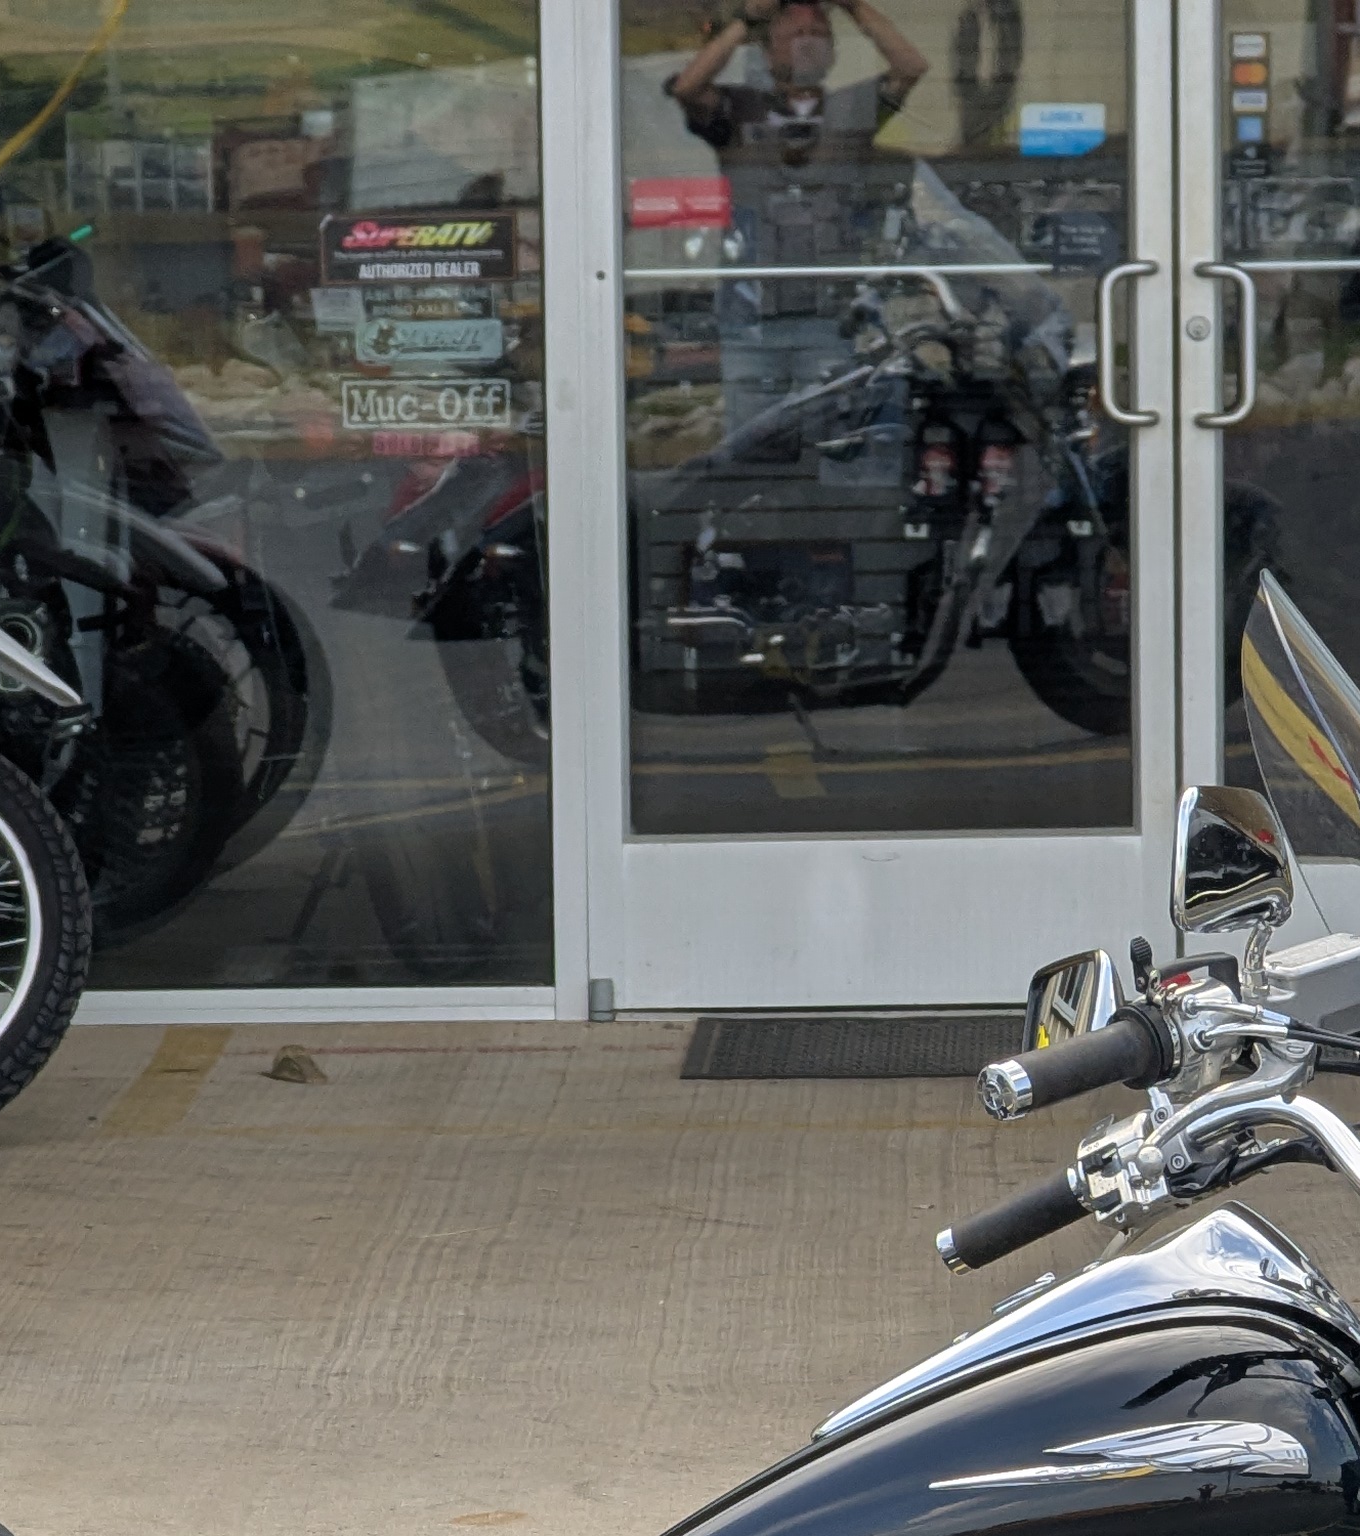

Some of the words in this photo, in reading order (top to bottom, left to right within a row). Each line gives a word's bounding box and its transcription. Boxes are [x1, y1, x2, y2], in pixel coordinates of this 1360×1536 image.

[359, 262, 431, 279] AUTHORIZED
[435, 261, 480, 277] DEALER
[350, 385, 504, 422] Muc-Off
